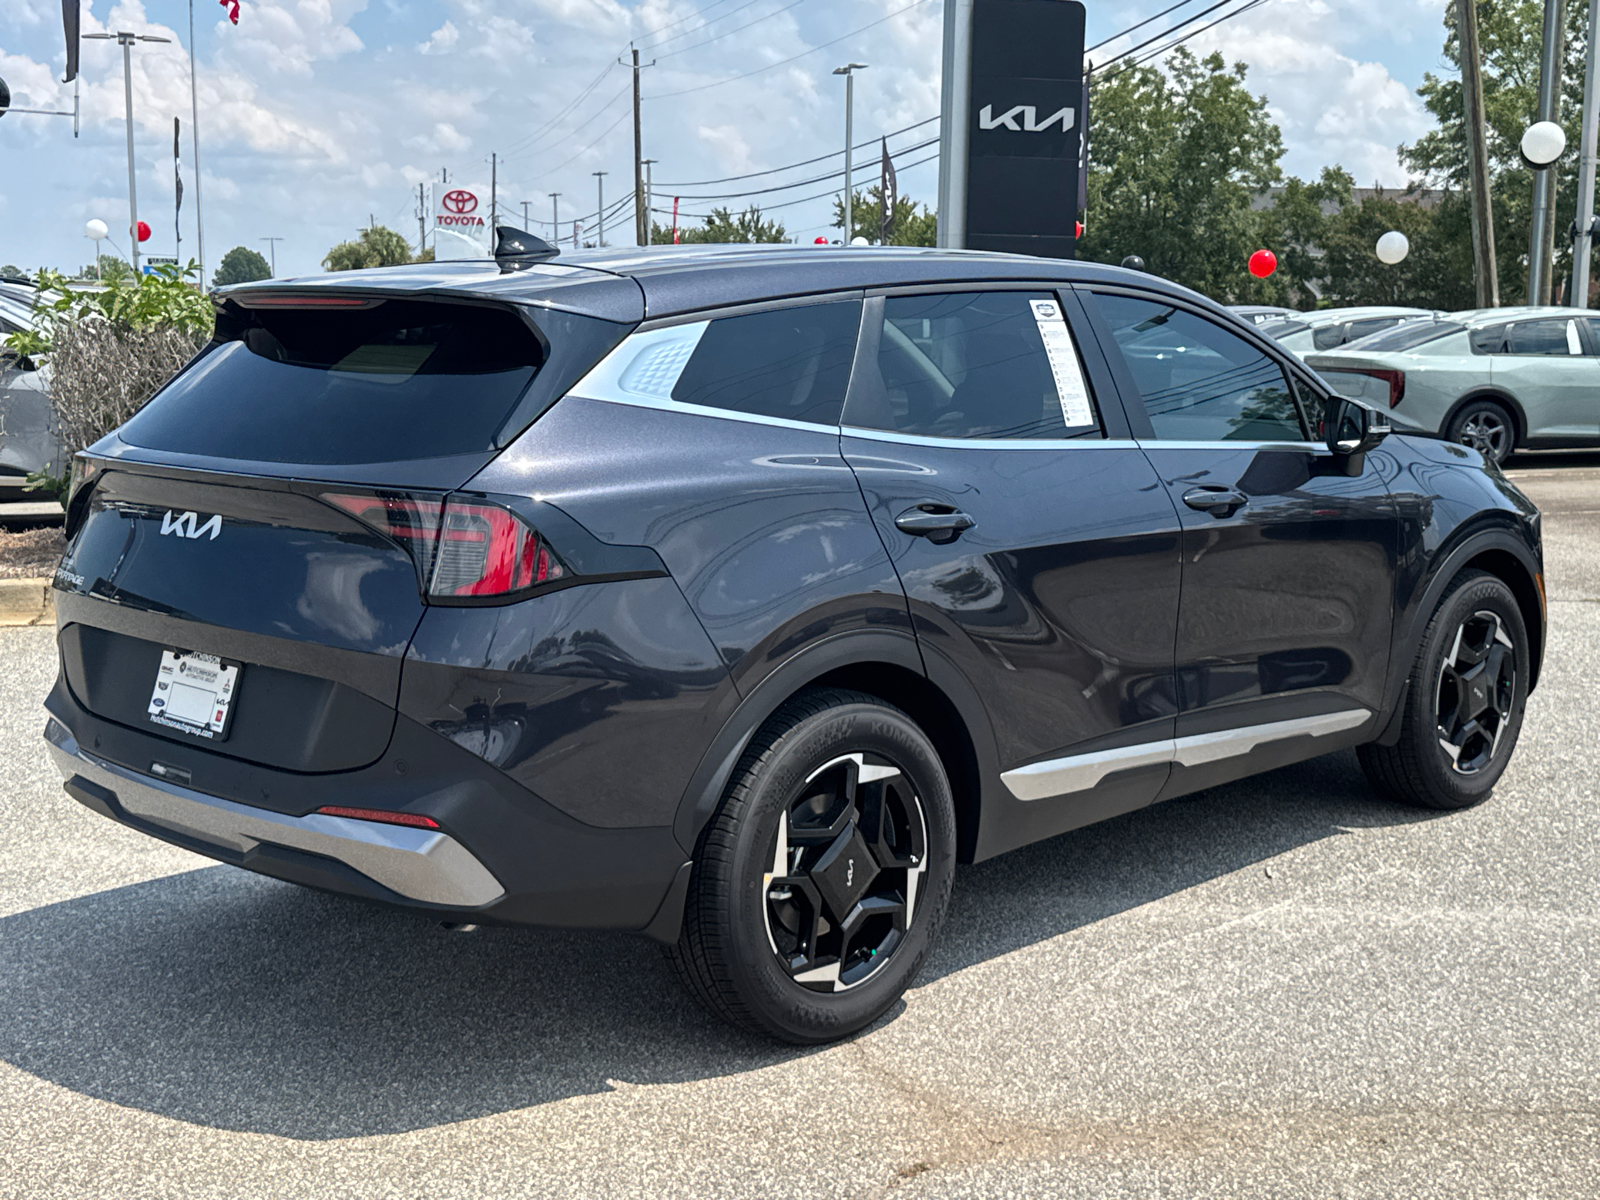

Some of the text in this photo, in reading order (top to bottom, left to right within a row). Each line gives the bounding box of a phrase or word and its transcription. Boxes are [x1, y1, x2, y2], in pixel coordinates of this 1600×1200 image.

[979, 103, 1075, 132] KIA
[436, 215, 485, 227] TOYOTA
[160, 509, 222, 541] KIA
[870, 720, 929, 761] KUMHO
